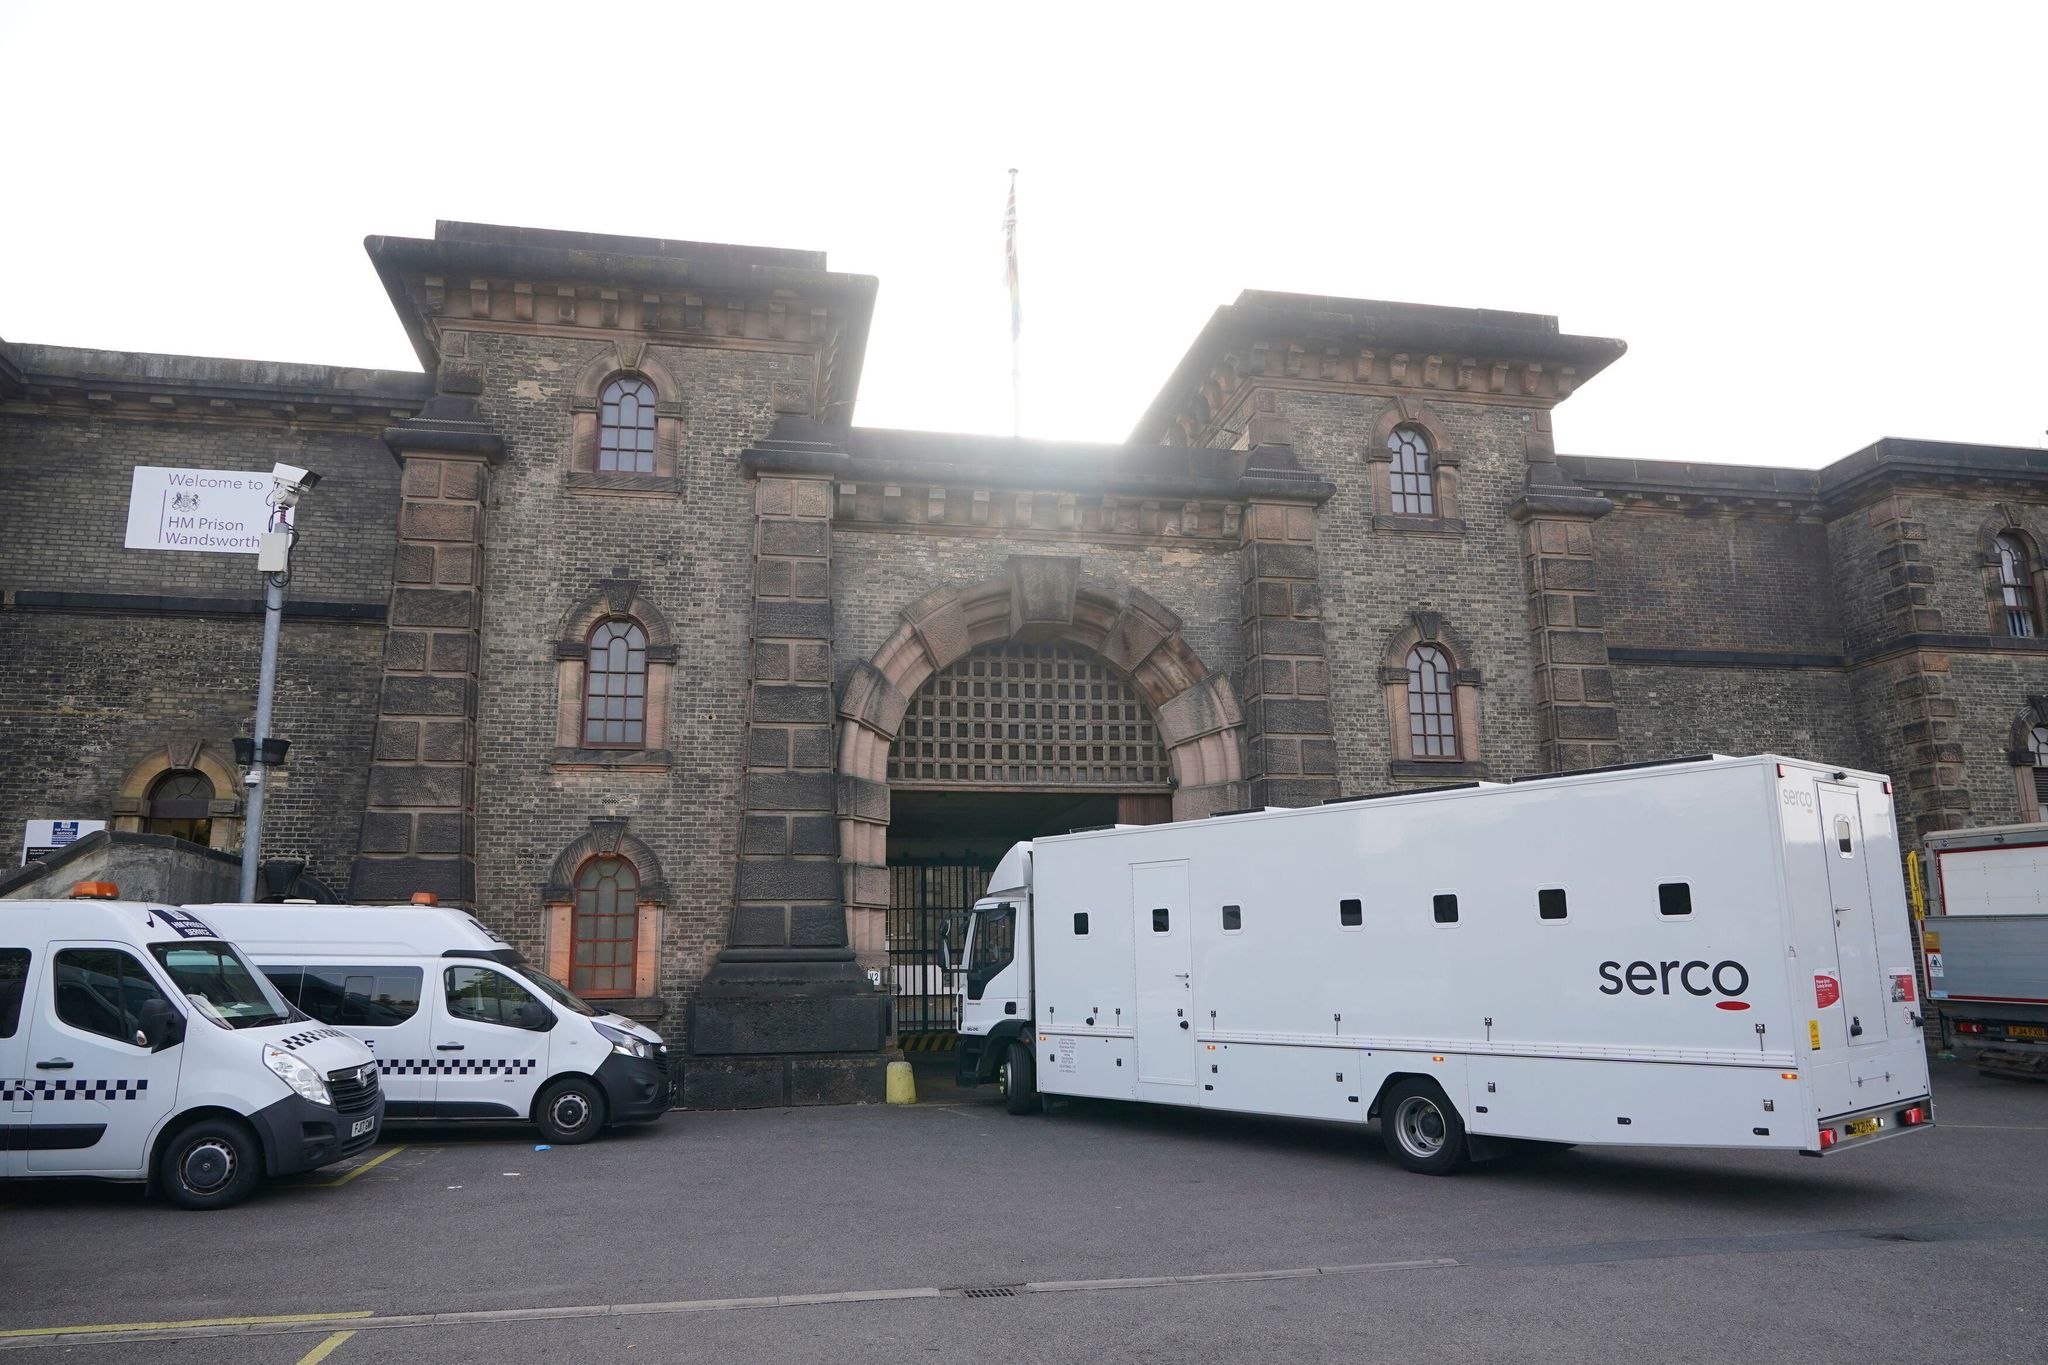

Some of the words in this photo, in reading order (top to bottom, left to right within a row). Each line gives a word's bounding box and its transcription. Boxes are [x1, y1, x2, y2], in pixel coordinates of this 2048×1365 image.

[168, 473, 243, 490] Welcome
[248, 479, 264, 491] to
[168, 516, 194, 529] HM
[198, 517, 244, 532] Prison
[165, 532, 260, 548] Wandsworth
[1783, 788, 1813, 808] serco
[185, 928, 212, 936] SERVICE
[1598, 960, 1749, 997] serco
